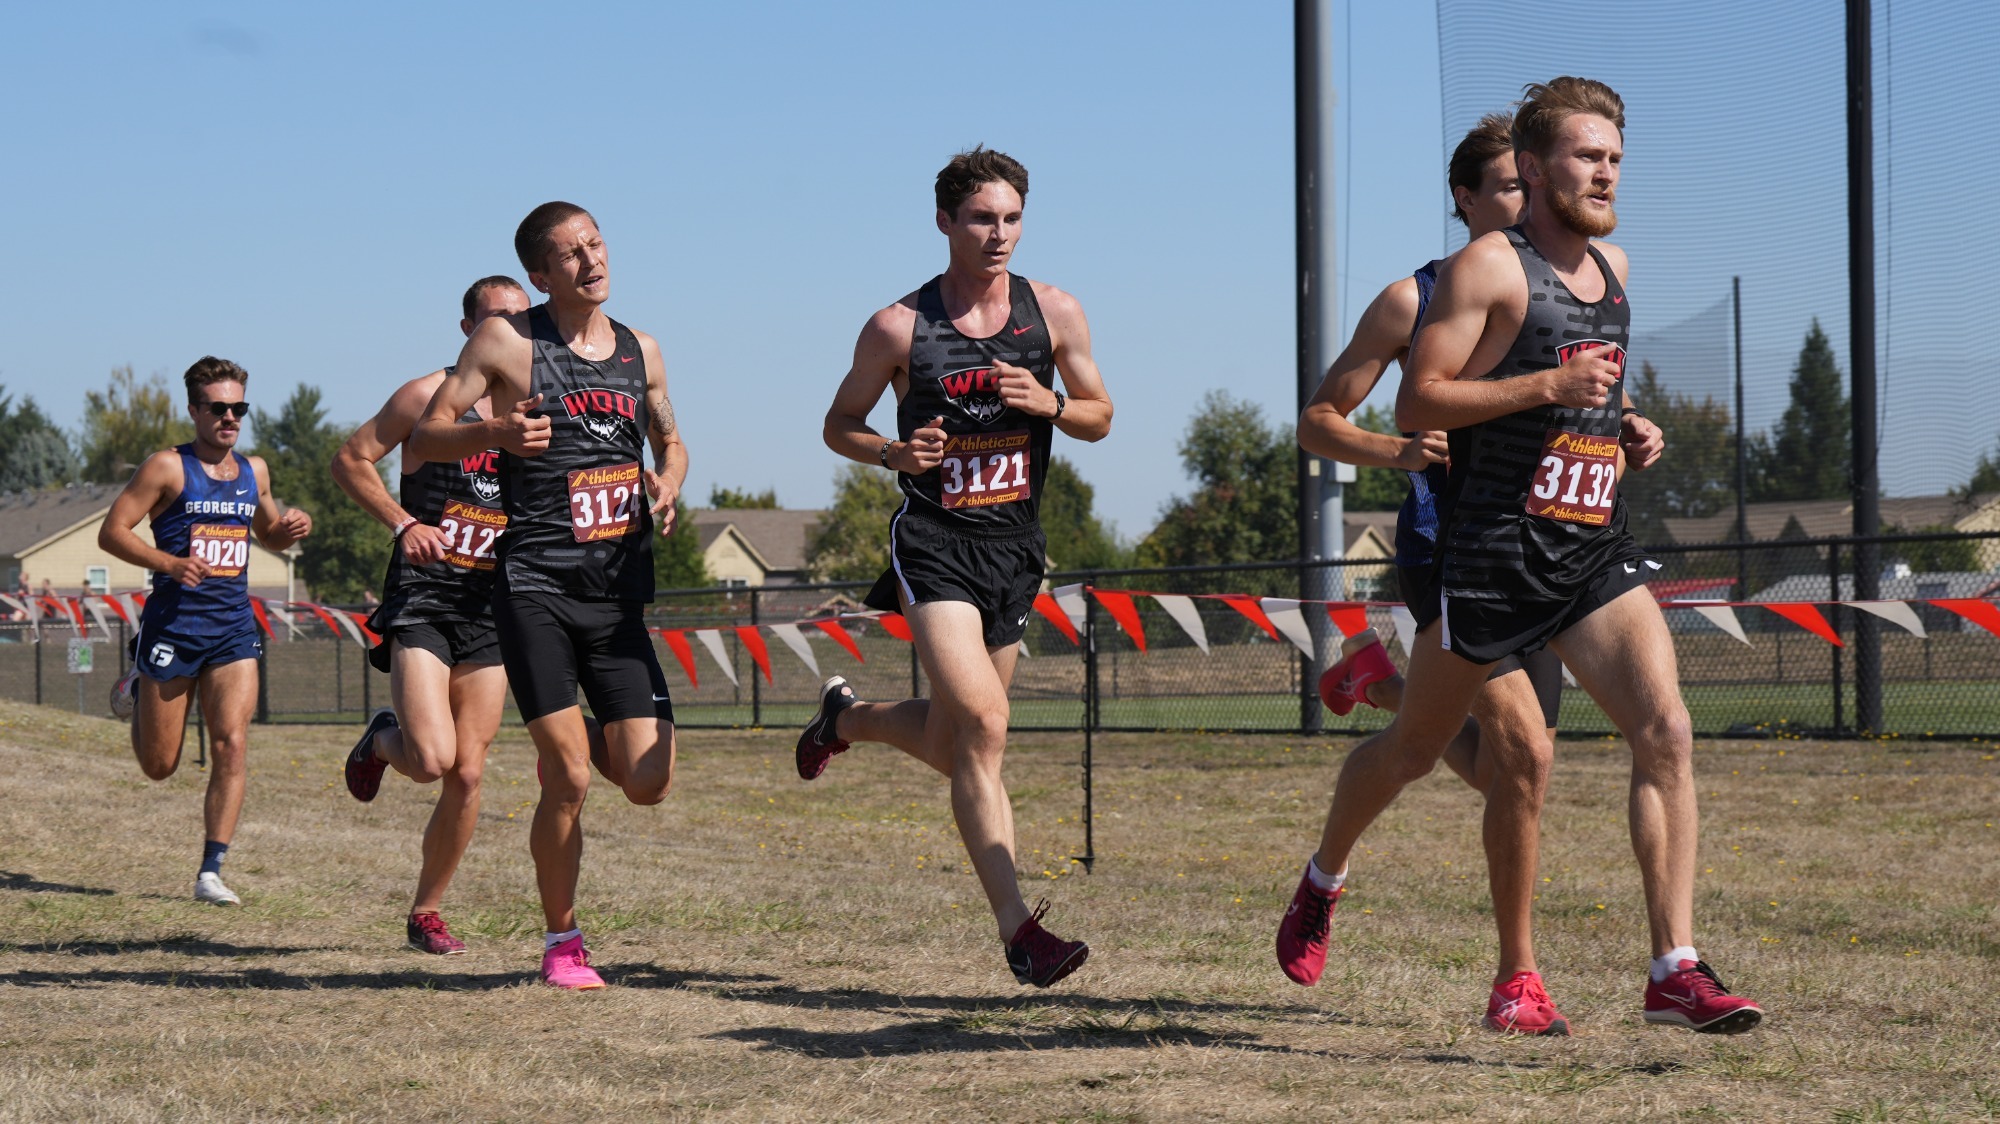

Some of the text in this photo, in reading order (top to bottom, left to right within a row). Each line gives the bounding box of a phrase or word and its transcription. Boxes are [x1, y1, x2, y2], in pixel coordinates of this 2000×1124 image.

[564, 389, 636, 421] WOU
[943, 450, 1026, 494] 3121
[1534, 455, 1615, 508] 3132
[185, 500, 256, 517] GEORGE FOX
[572, 482, 640, 528] 3124
[191, 539, 247, 567] 3020
[441, 518, 504, 559] 312
